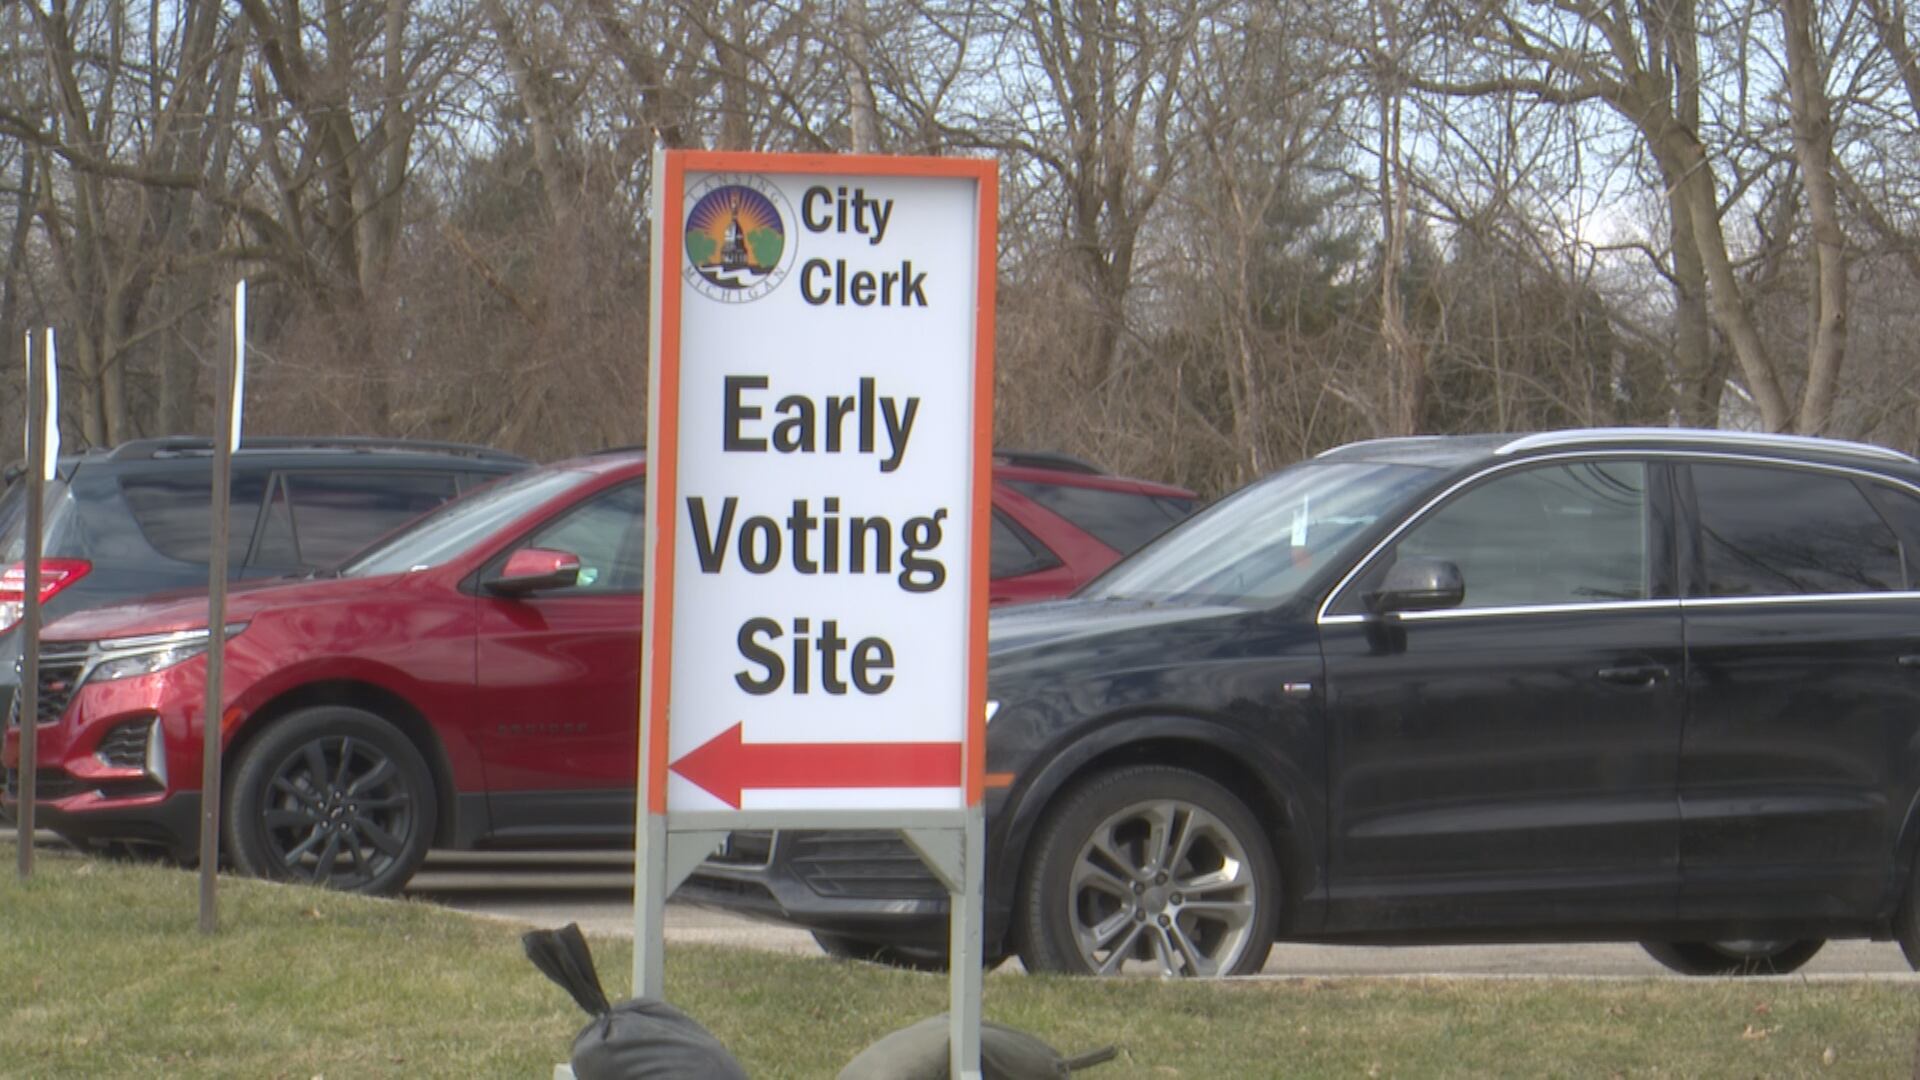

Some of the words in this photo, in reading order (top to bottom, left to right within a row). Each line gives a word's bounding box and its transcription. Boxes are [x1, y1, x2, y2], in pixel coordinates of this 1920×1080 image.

[688, 172, 781, 204] LANSING
[801, 185, 893, 245] City
[686, 265, 785, 301] MICHIGAN
[800, 259, 927, 306] Clerk
[723, 375, 919, 472] Early
[686, 496, 947, 592] Voting
[735, 617, 894, 695] Site
